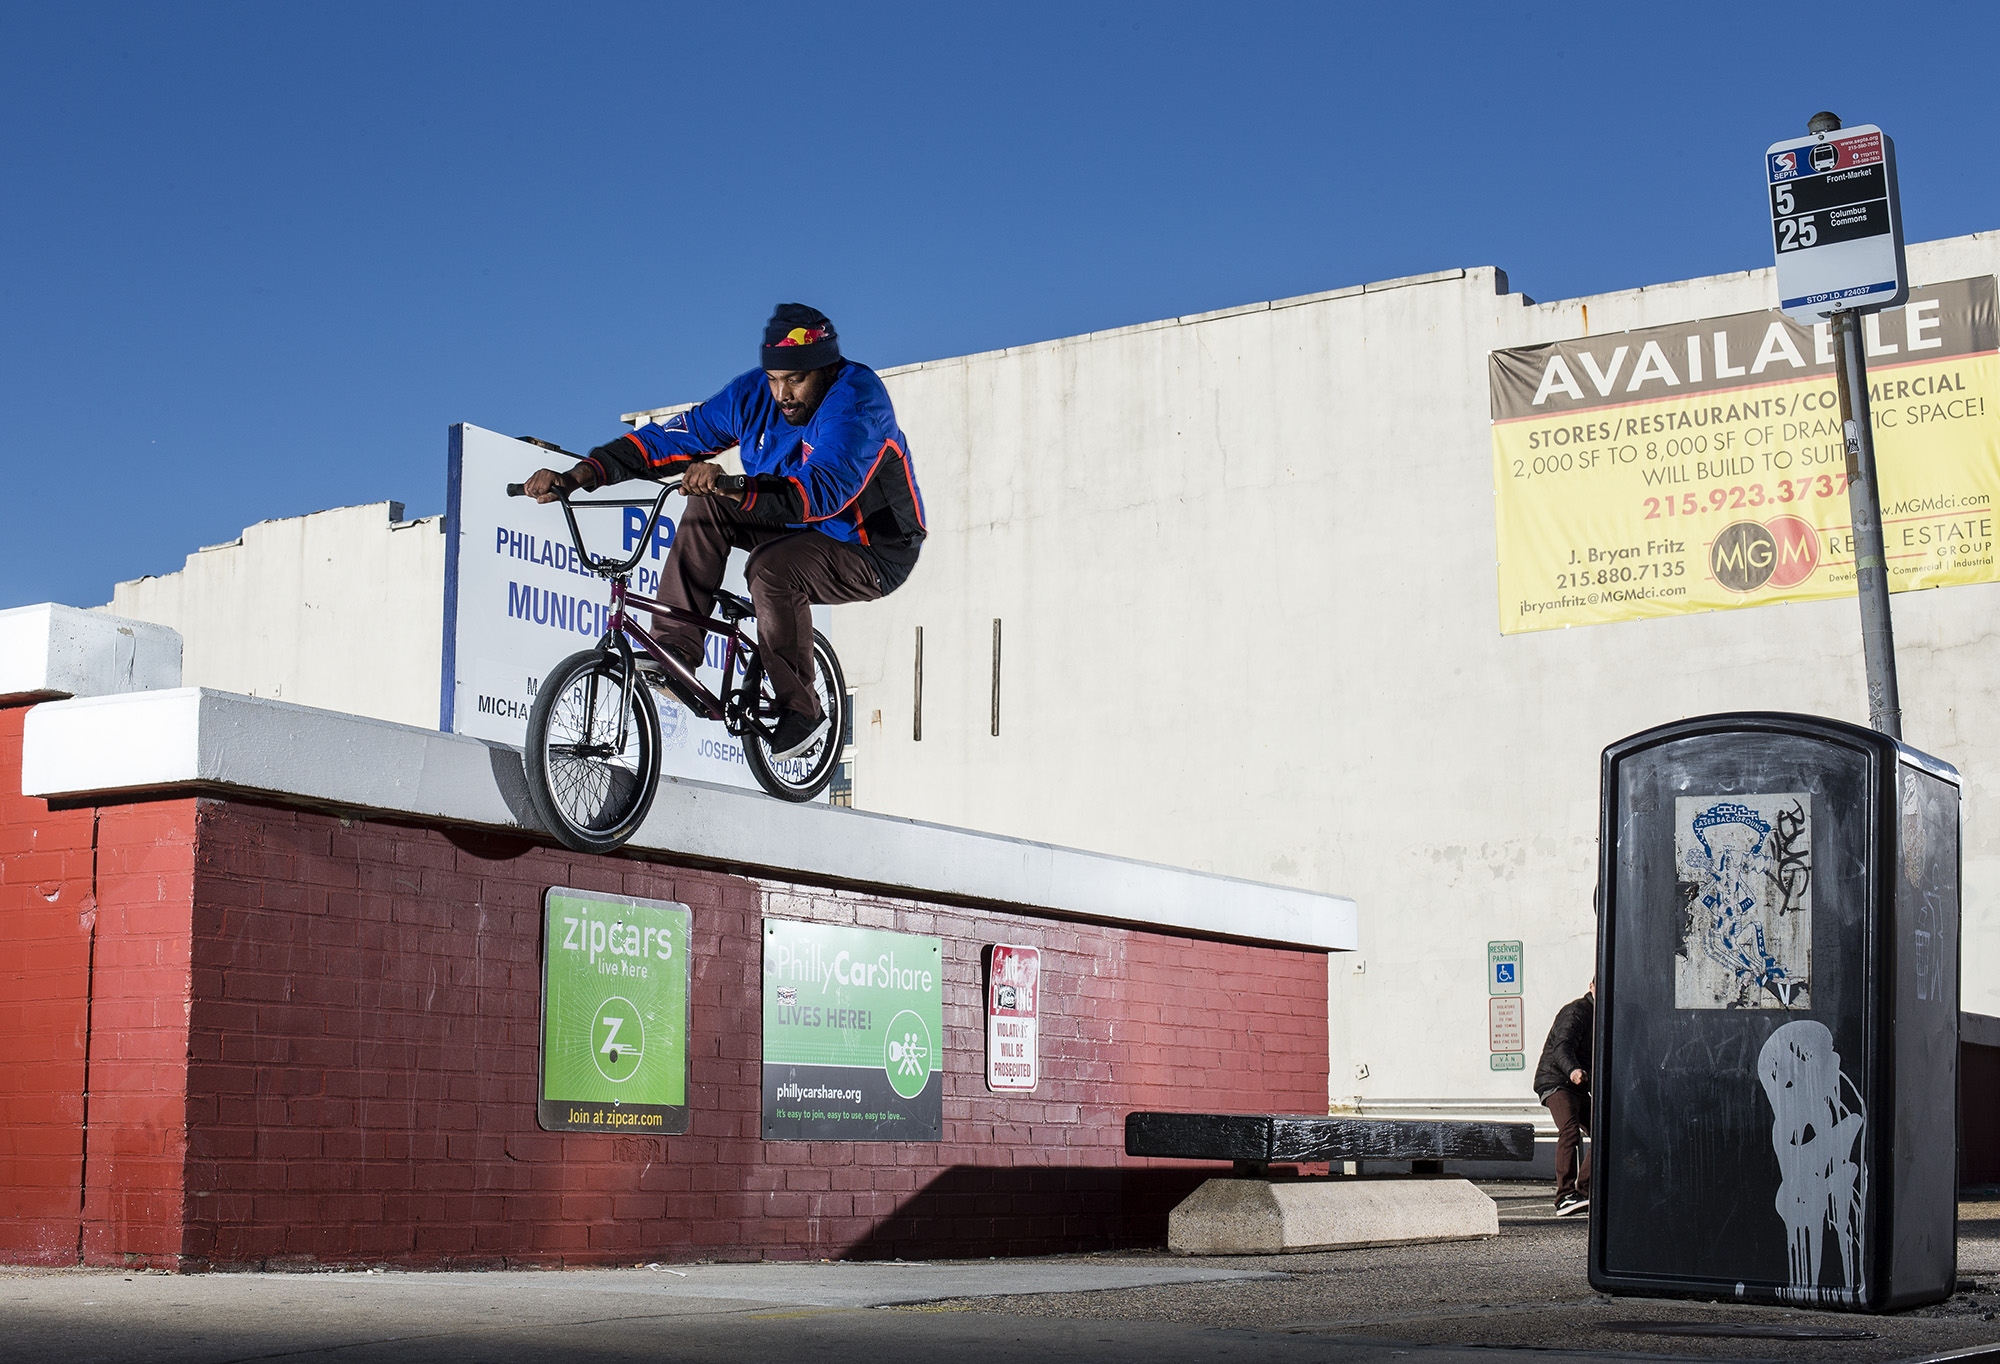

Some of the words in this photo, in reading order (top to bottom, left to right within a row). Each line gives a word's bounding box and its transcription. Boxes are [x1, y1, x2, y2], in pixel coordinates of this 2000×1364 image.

[1840, 135, 1879, 147] www.septa.org
[1774, 170, 1798, 181] SEPTA
[1826, 168, 1872, 184] Front-Market
[1775, 183, 1795, 215] 5
[1830, 206, 1867, 219] Columbus
[1831, 214, 1868, 227] Commons
[1779, 215, 1818, 251] 25
[1806, 293, 1828, 304] STOP
[1829, 290, 1842, 300] I.D.
[1843, 286, 1870, 298] #24037
[1529, 372, 1966, 450] STORES/RESTAURANTS/COMERCIAL
[1513, 453, 1573, 479] 2,000
[1579, 449, 1600, 469] SF
[1608, 445, 1638, 465] TO
[1646, 435, 1707, 462] 8,000
[1714, 430, 1736, 451] SF
[1744, 426, 1774, 447] OF
[1784, 409, 1897, 442] DRAMIC
[1907, 397, 1985, 424] SPACE!
[1642, 464, 1690, 486] WILL
[1697, 456, 1755, 480] BUILD
[1762, 450, 1793, 471] TO
[1801, 442, 1844, 466] SUIT
[1643, 472, 1849, 520] 215.923.3737
[1903, 518, 1993, 546] ESTATE
[496, 527, 632, 589] PHILADELP
[1568, 550, 1582, 565] J.
[1588, 546, 1641, 565] Bryan
[1647, 539, 1685, 556] Fritz
[1937, 541, 1992, 557] GROUP
[1556, 561, 1686, 590] 215.880.7135
[1892, 560, 1942, 575] Commercial
[1954, 555, 1994, 568] Industrial
[1520, 586, 1687, 616] jbryanfritz@MGMdci.com
[508, 581, 645, 650] MUNICIPL
[697, 738, 744, 765] JOSEPH
[1694, 816, 1716, 828] LASER
[1716, 814, 1765, 832] BACKGROUND
[563, 907, 672, 964] zipcars
[1757, 931, 1766, 952] KFN
[1489, 945, 1519, 954] RESERVED
[1492, 955, 1518, 963] PARKING
[598, 957, 618, 976] live
[621, 959, 648, 979] here
[777, 941, 933, 994] PhillyCarShare
[778, 1005, 821, 1028] LIVES
[826, 1007, 872, 1030] HERE!
[1001, 1042, 1015, 1058] WILL
[1016, 1043, 1024, 1058] BE
[994, 1062, 1032, 1078] PROSECUTED
[776, 1082, 862, 1104] phillycarshare.org
[567, 1108, 590, 1124] Join
[593, 1110, 604, 1124] at
[606, 1110, 663, 1128] zipcar.com
[776, 1108, 786, 1118] It's
[787, 1111, 802, 1121] easy
[803, 1110, 811, 1119] to
[812, 1109, 826, 1121] join,
[827, 1112, 842, 1121] easy
[842, 1111, 849, 1119] to
[851, 1112, 864, 1121] use,
[864, 1113, 879, 1122] easy
[879, 1112, 887, 1120] to
